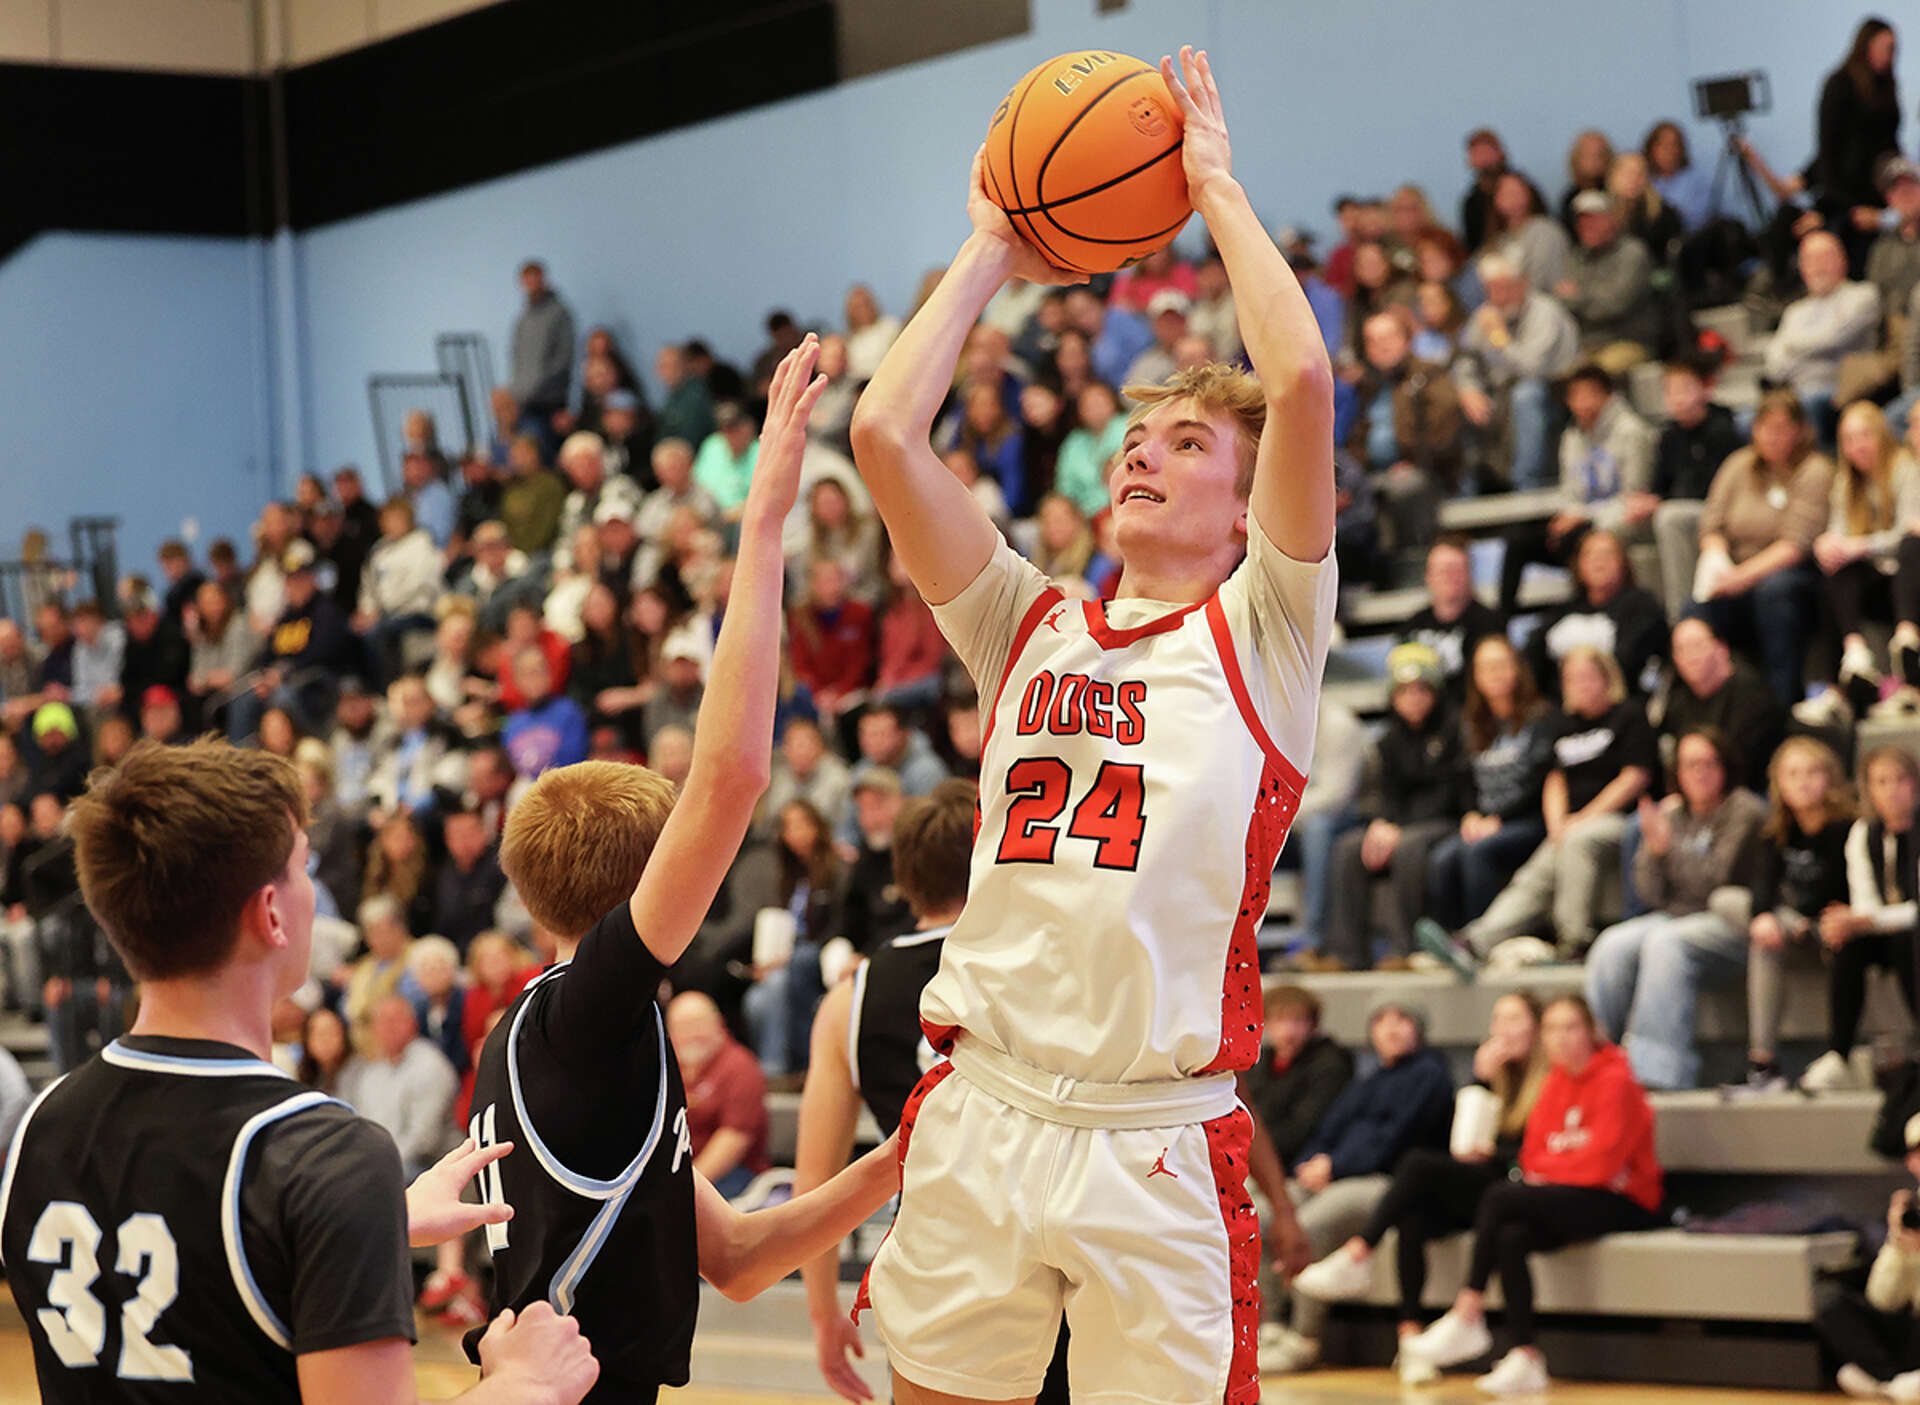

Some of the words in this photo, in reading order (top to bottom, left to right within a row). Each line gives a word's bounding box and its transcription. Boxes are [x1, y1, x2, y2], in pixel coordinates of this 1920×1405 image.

[1017, 669, 1146, 745] DOGS
[995, 757, 1147, 872] 24
[26, 1201, 195, 1383] 32
